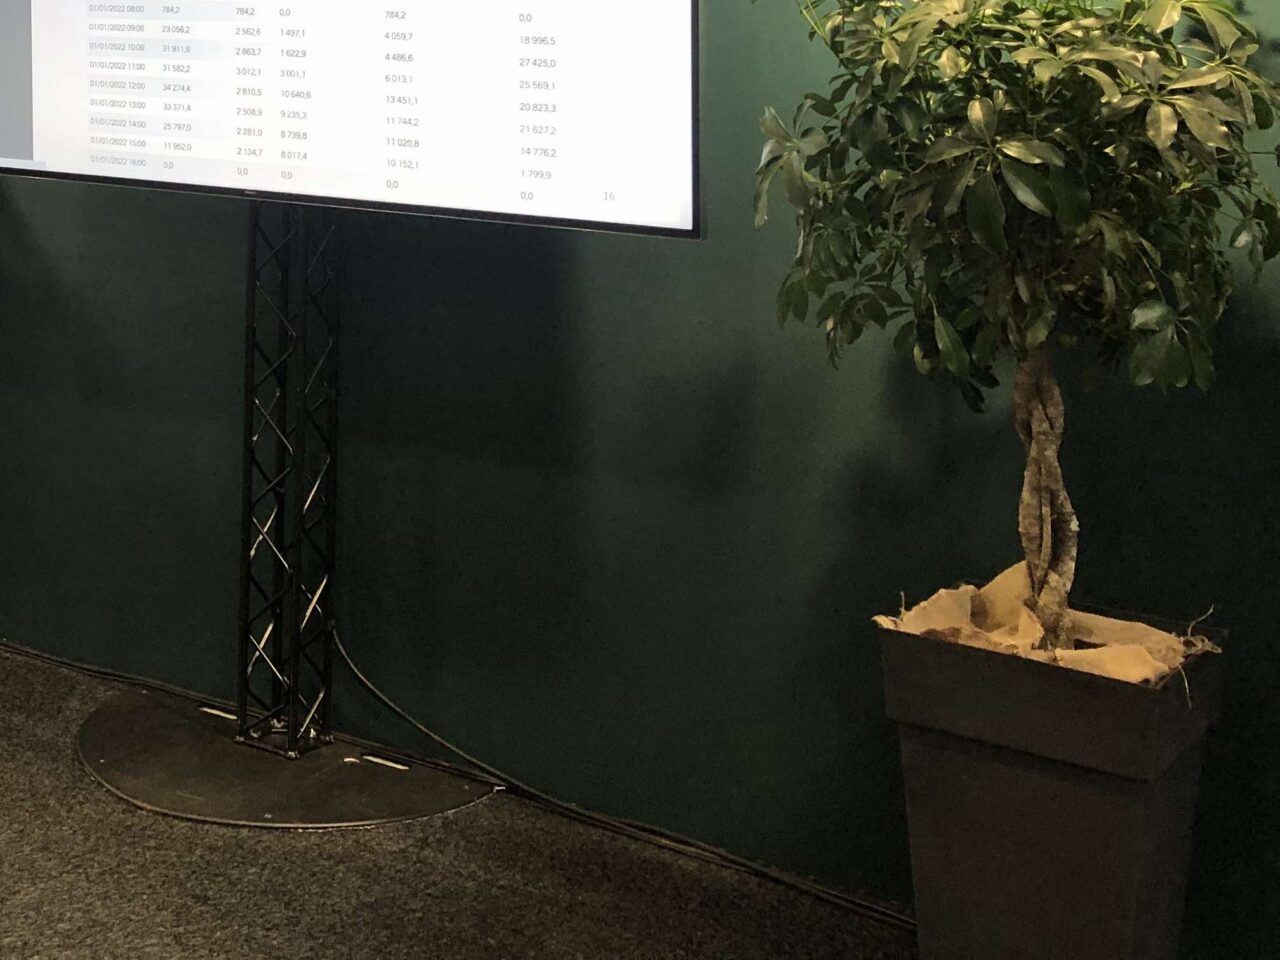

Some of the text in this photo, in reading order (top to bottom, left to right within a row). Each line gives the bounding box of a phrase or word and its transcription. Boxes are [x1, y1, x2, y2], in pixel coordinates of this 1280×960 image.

[235, 8, 256, 17] 784,2
[518, 14, 532, 23] 0,0
[603, 191, 615, 201] 16
